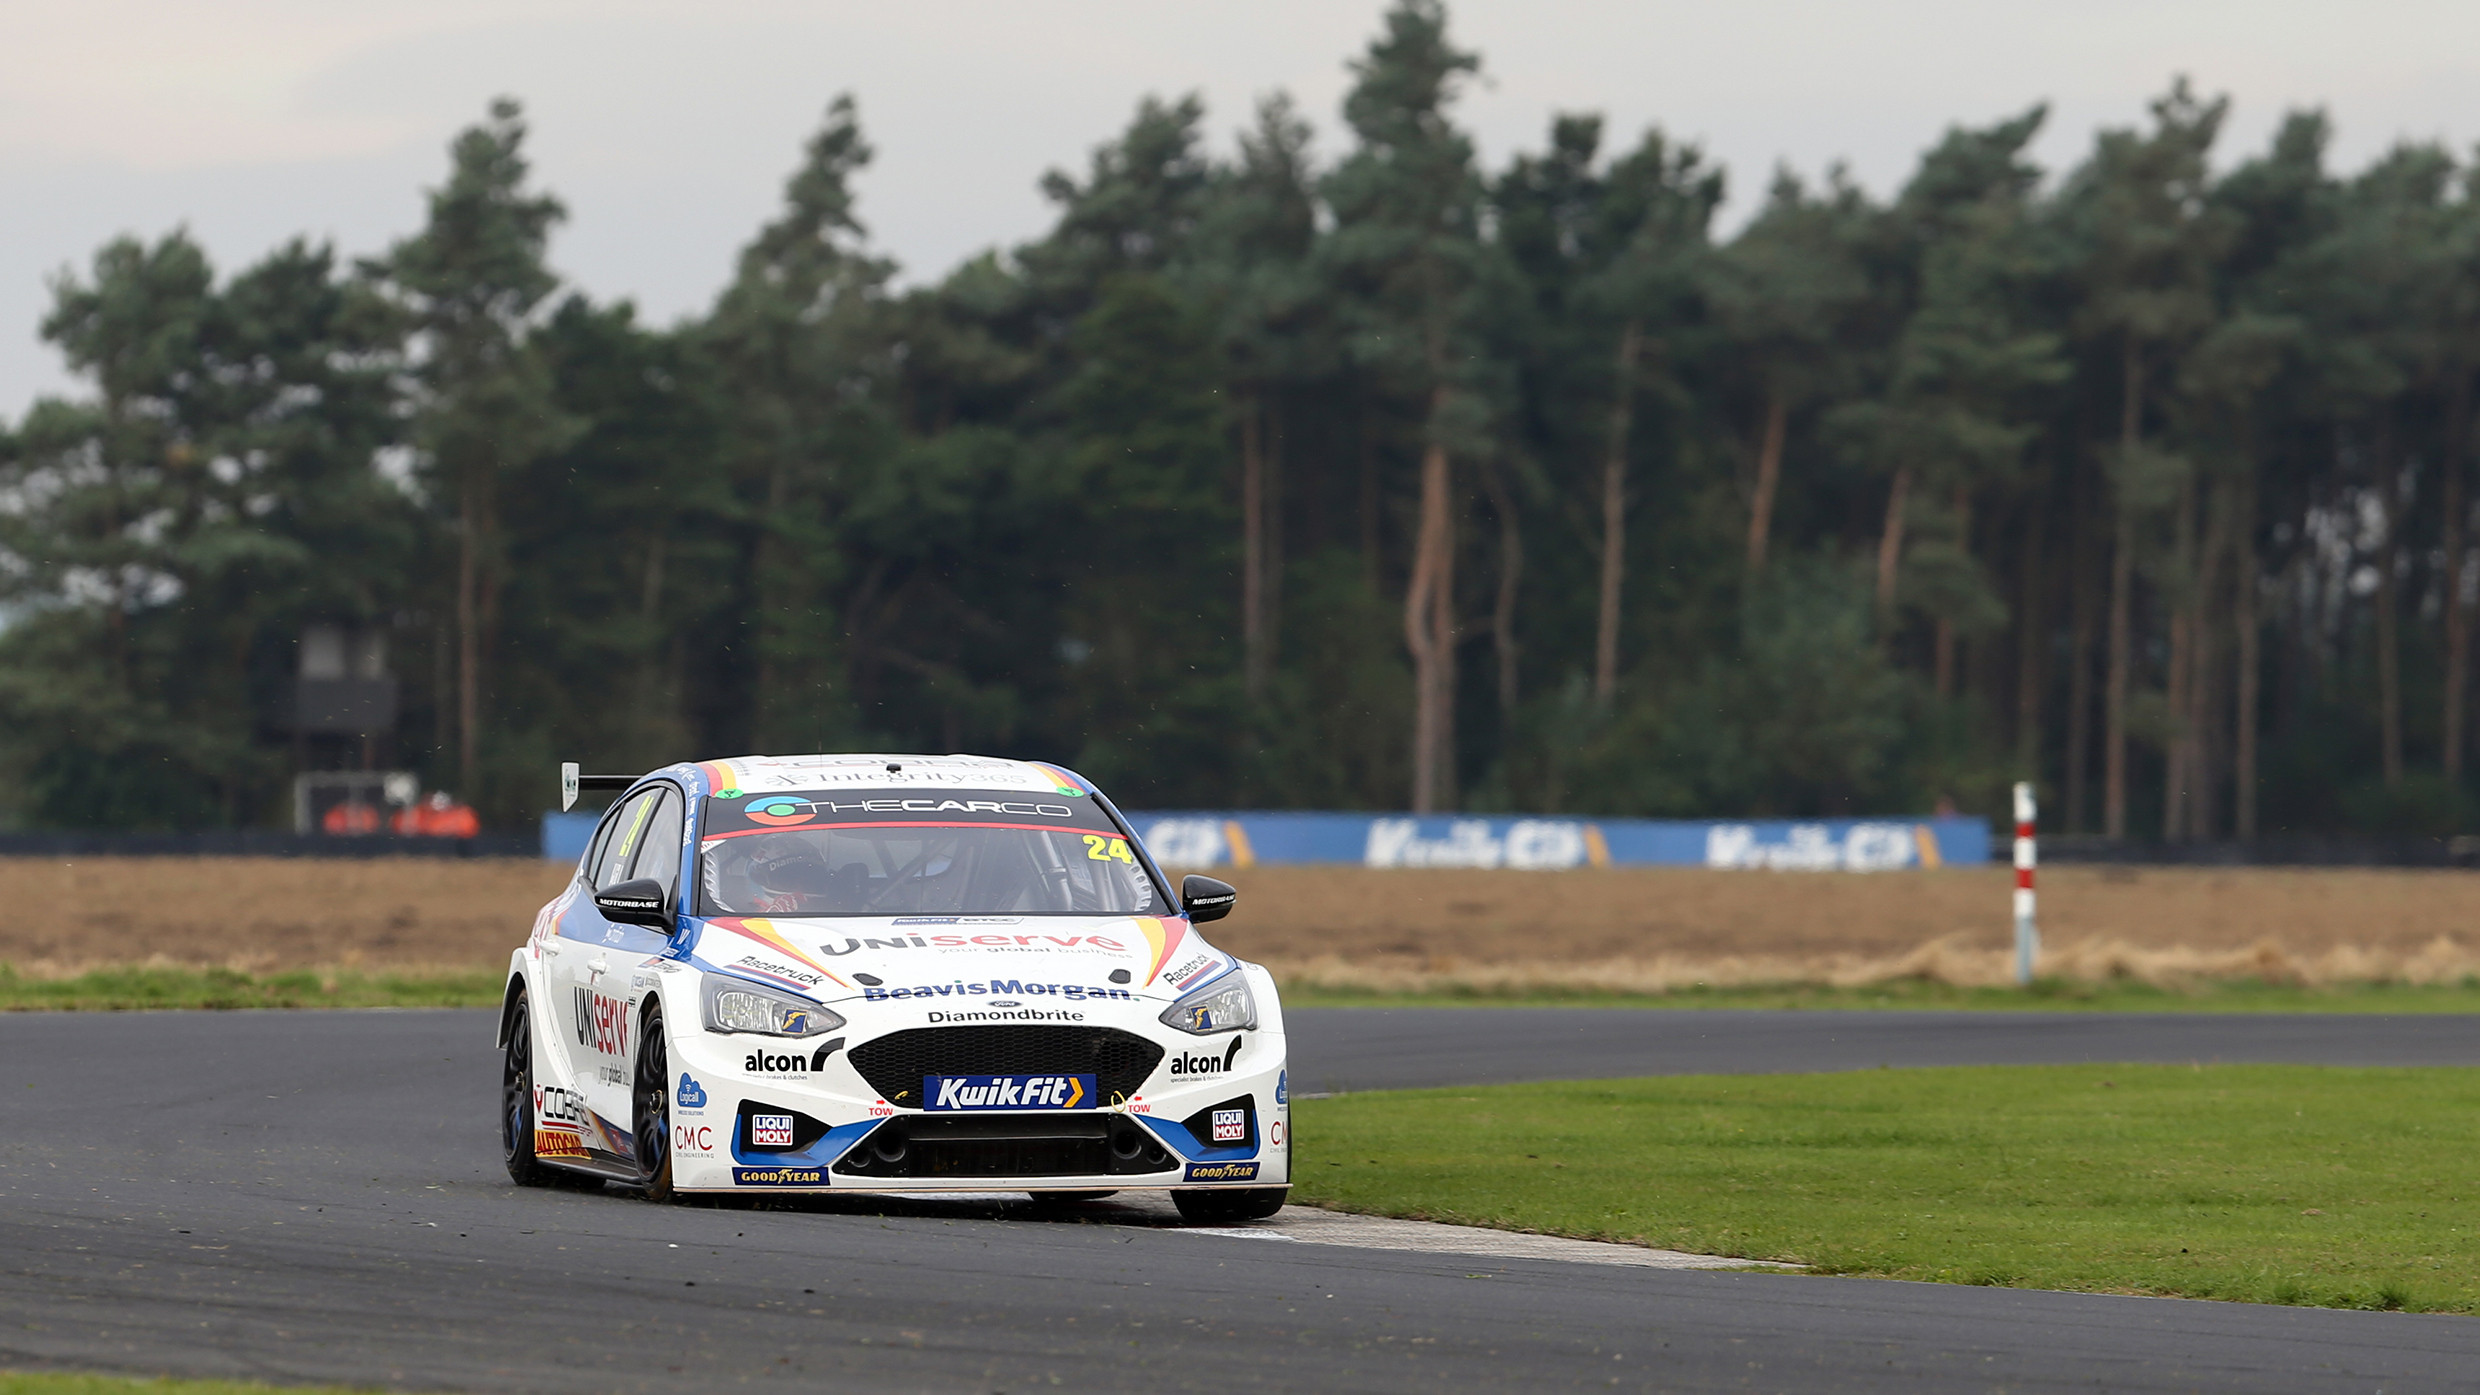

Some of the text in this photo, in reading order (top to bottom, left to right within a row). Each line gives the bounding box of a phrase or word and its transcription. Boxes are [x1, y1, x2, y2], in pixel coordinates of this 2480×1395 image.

[1082, 834, 1134, 865] 24
[600, 898, 660, 909] MOTORBASE
[1057, 947, 1133, 959] business
[736, 955, 824, 985] Racetruck
[1163, 952, 1211, 985] Racetruck
[928, 1009, 1084, 1023] Diamondbrite
[745, 1049, 807, 1072] alcon
[1171, 1051, 1221, 1075] alcon
[868, 1107, 893, 1116] TOW
[1128, 1104, 1151, 1113] TOW
[756, 1117, 790, 1129] LIQUI
[1215, 1113, 1242, 1125] LIQUI
[675, 1125, 713, 1151] CMC
[756, 1130, 791, 1143] MOLY
[1215, 1125, 1243, 1138] MOLY
